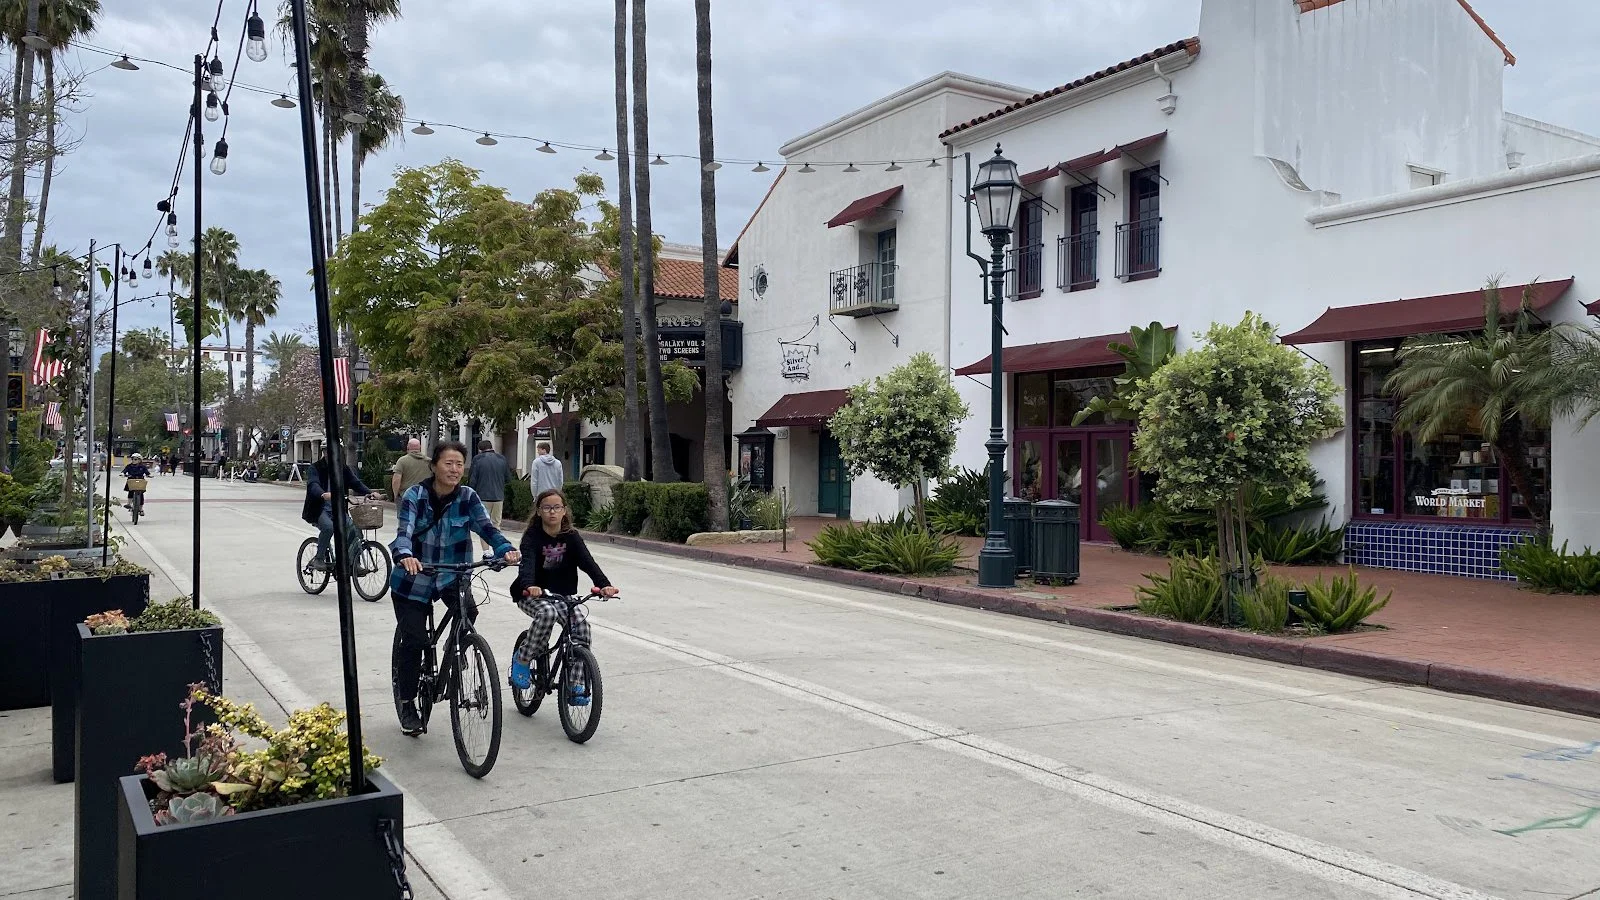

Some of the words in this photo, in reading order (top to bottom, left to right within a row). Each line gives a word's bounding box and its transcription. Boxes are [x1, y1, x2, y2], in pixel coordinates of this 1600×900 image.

[786, 357, 804, 366] Silver
[1415, 495, 1446, 507] WORLD
[1449, 496, 1486, 508] MARKET
